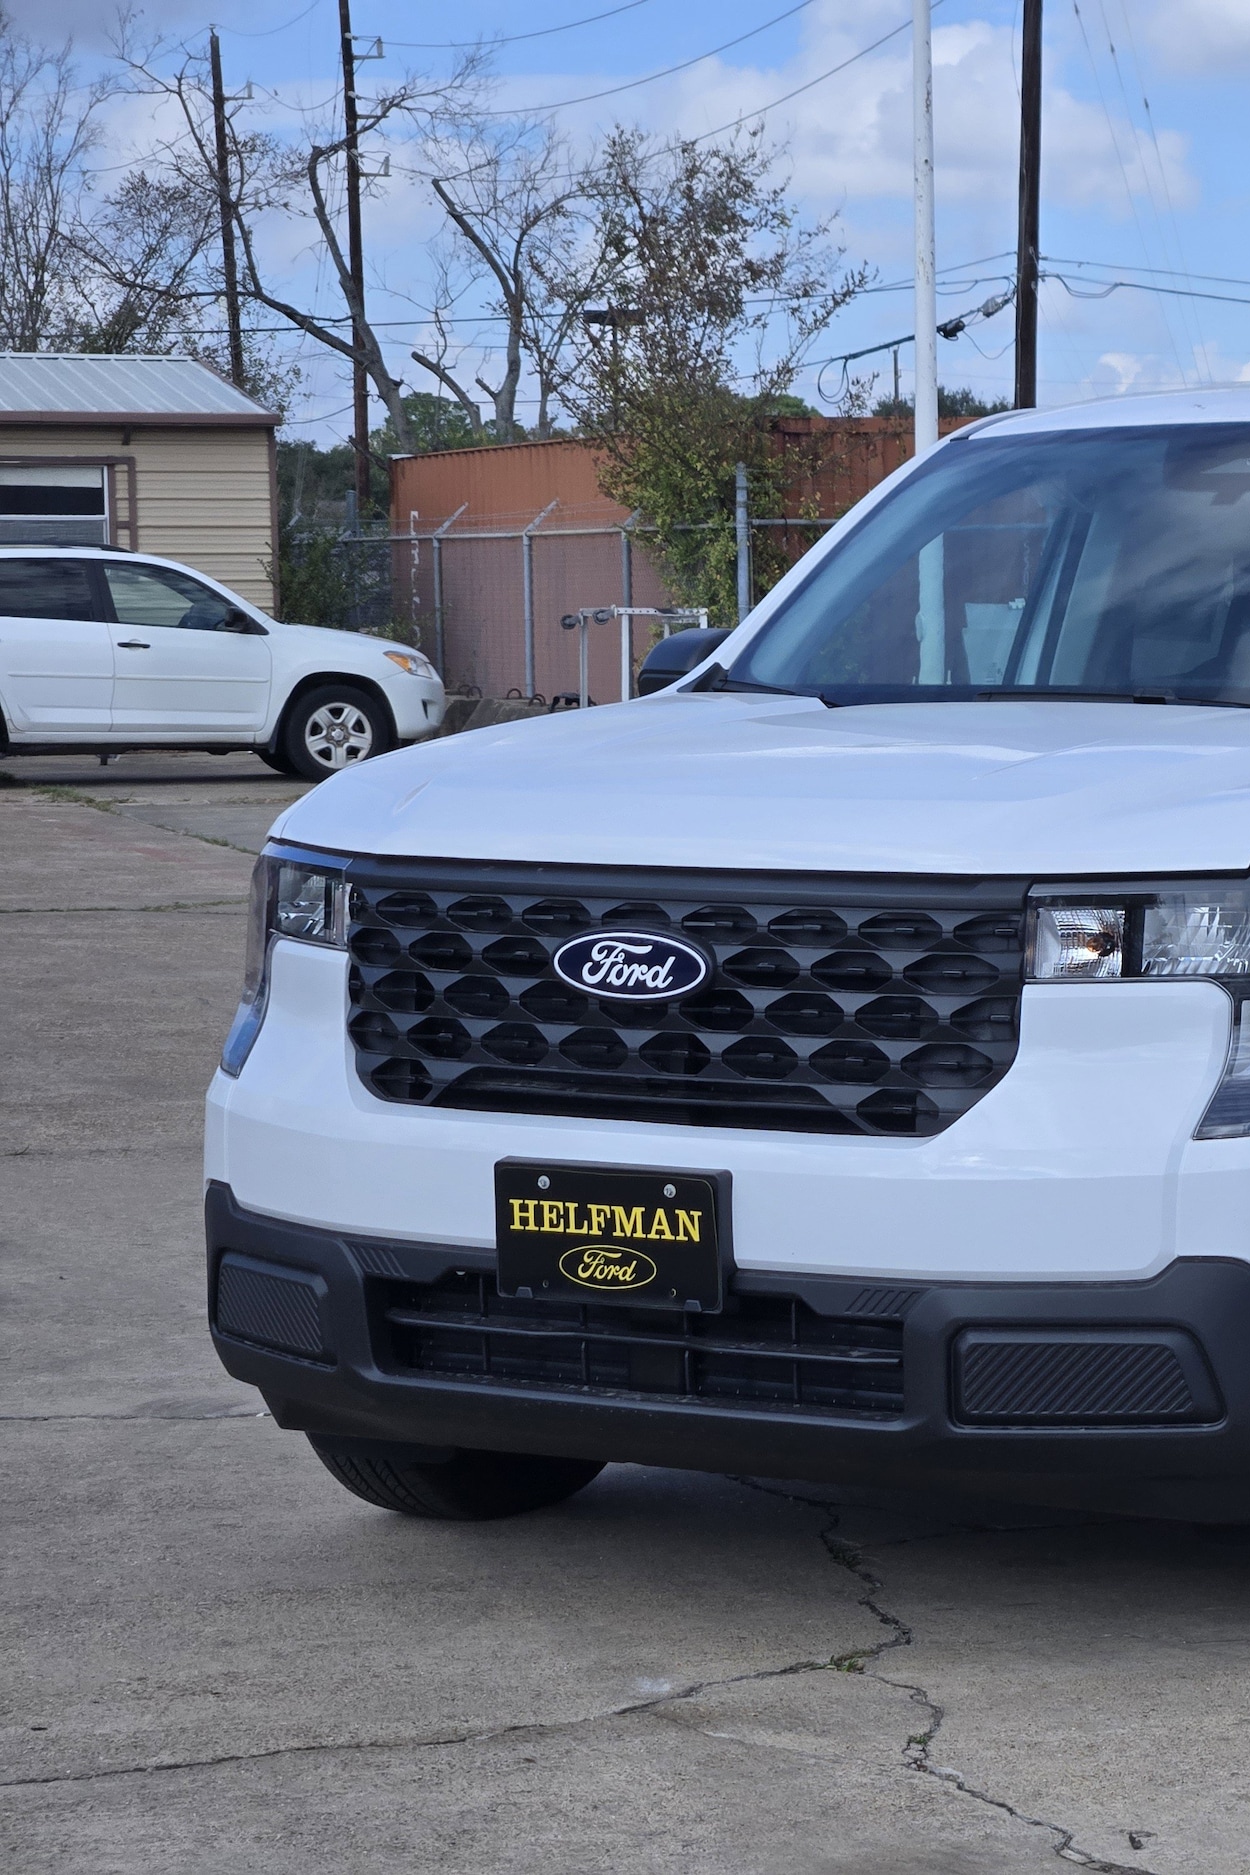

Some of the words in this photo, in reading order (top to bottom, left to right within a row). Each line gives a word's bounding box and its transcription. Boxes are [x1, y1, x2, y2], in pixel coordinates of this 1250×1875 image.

[581, 940, 676, 989] Ford
[508, 1198, 703, 1243] HELFMAN
[577, 1249, 638, 1282] Ford
